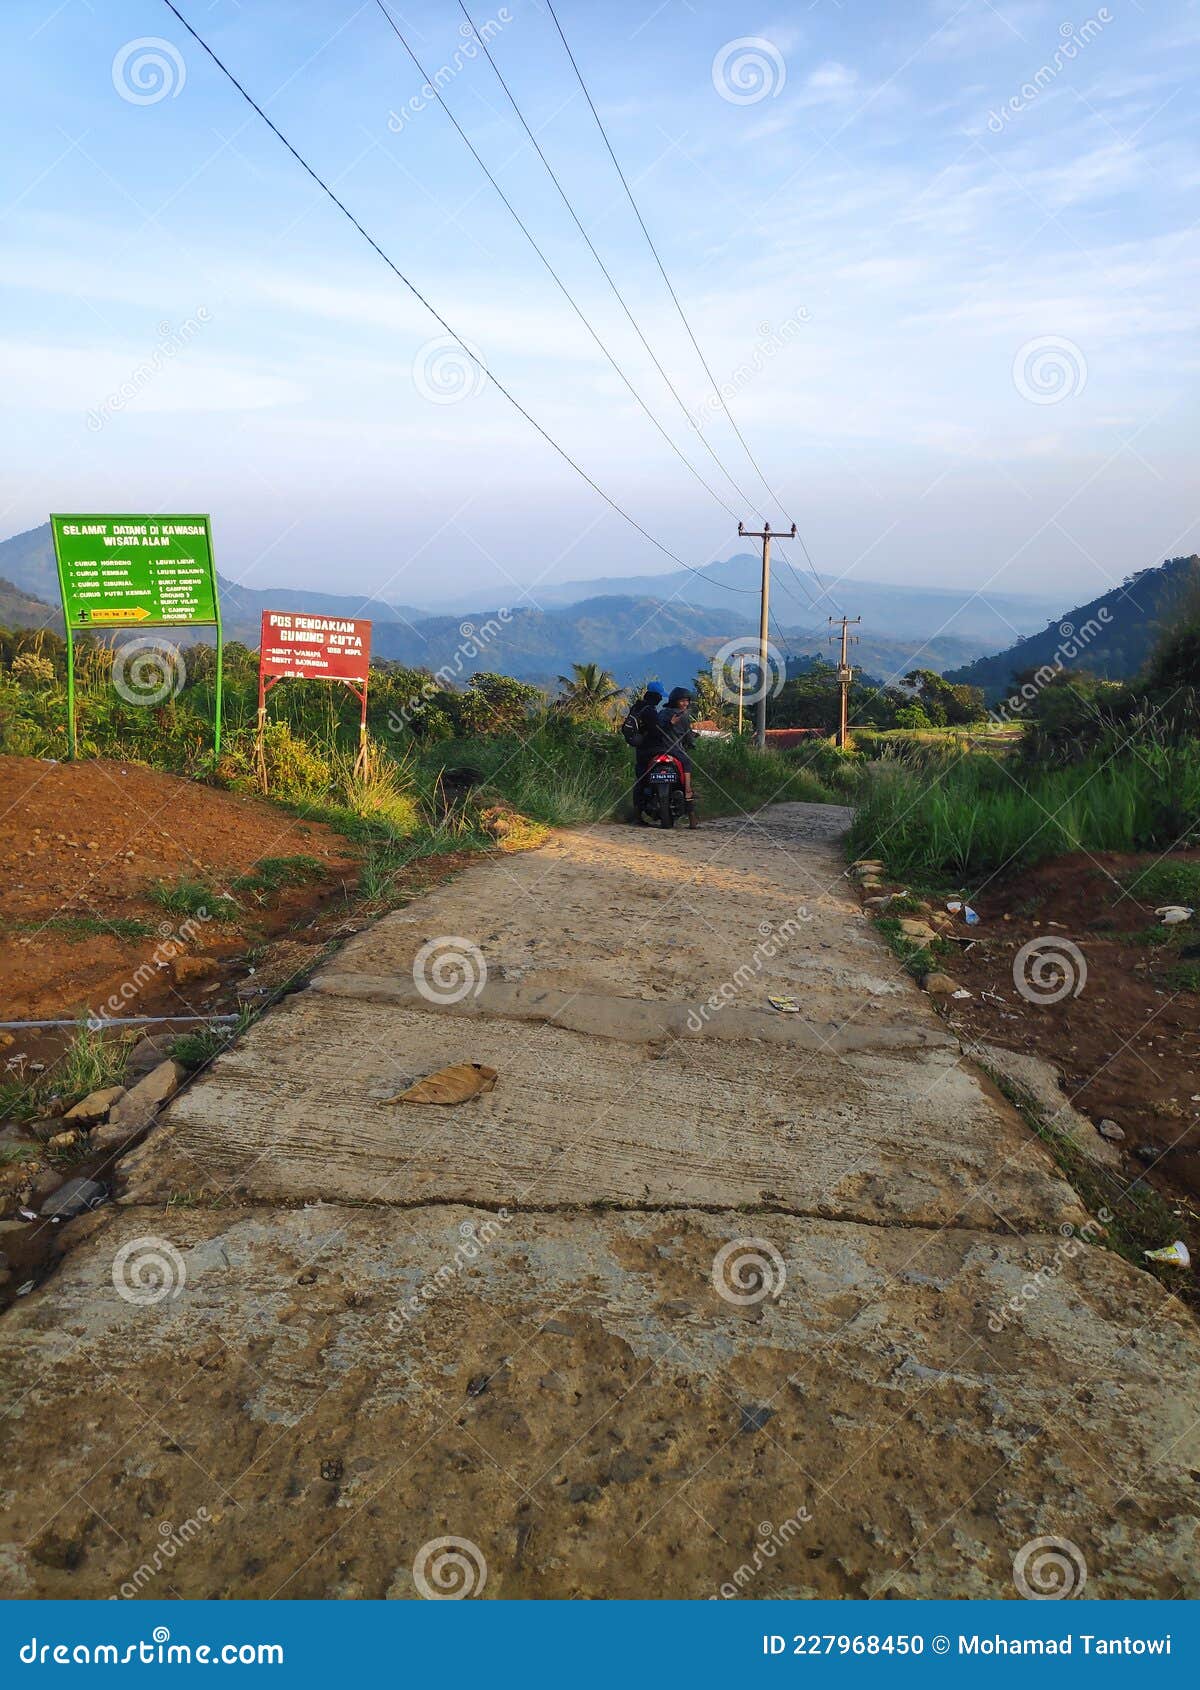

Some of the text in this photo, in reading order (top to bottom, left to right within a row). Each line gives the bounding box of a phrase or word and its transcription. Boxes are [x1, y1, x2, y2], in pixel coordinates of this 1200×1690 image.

[63, 525, 206, 535] SELAMAT DATANG DI KAWASAN
[103, 537, 170, 546] WISATA ALAM
[270, 615, 355, 633] POS PENDAKIAN
[280, 630, 362, 647] GUNUNG KUTA
